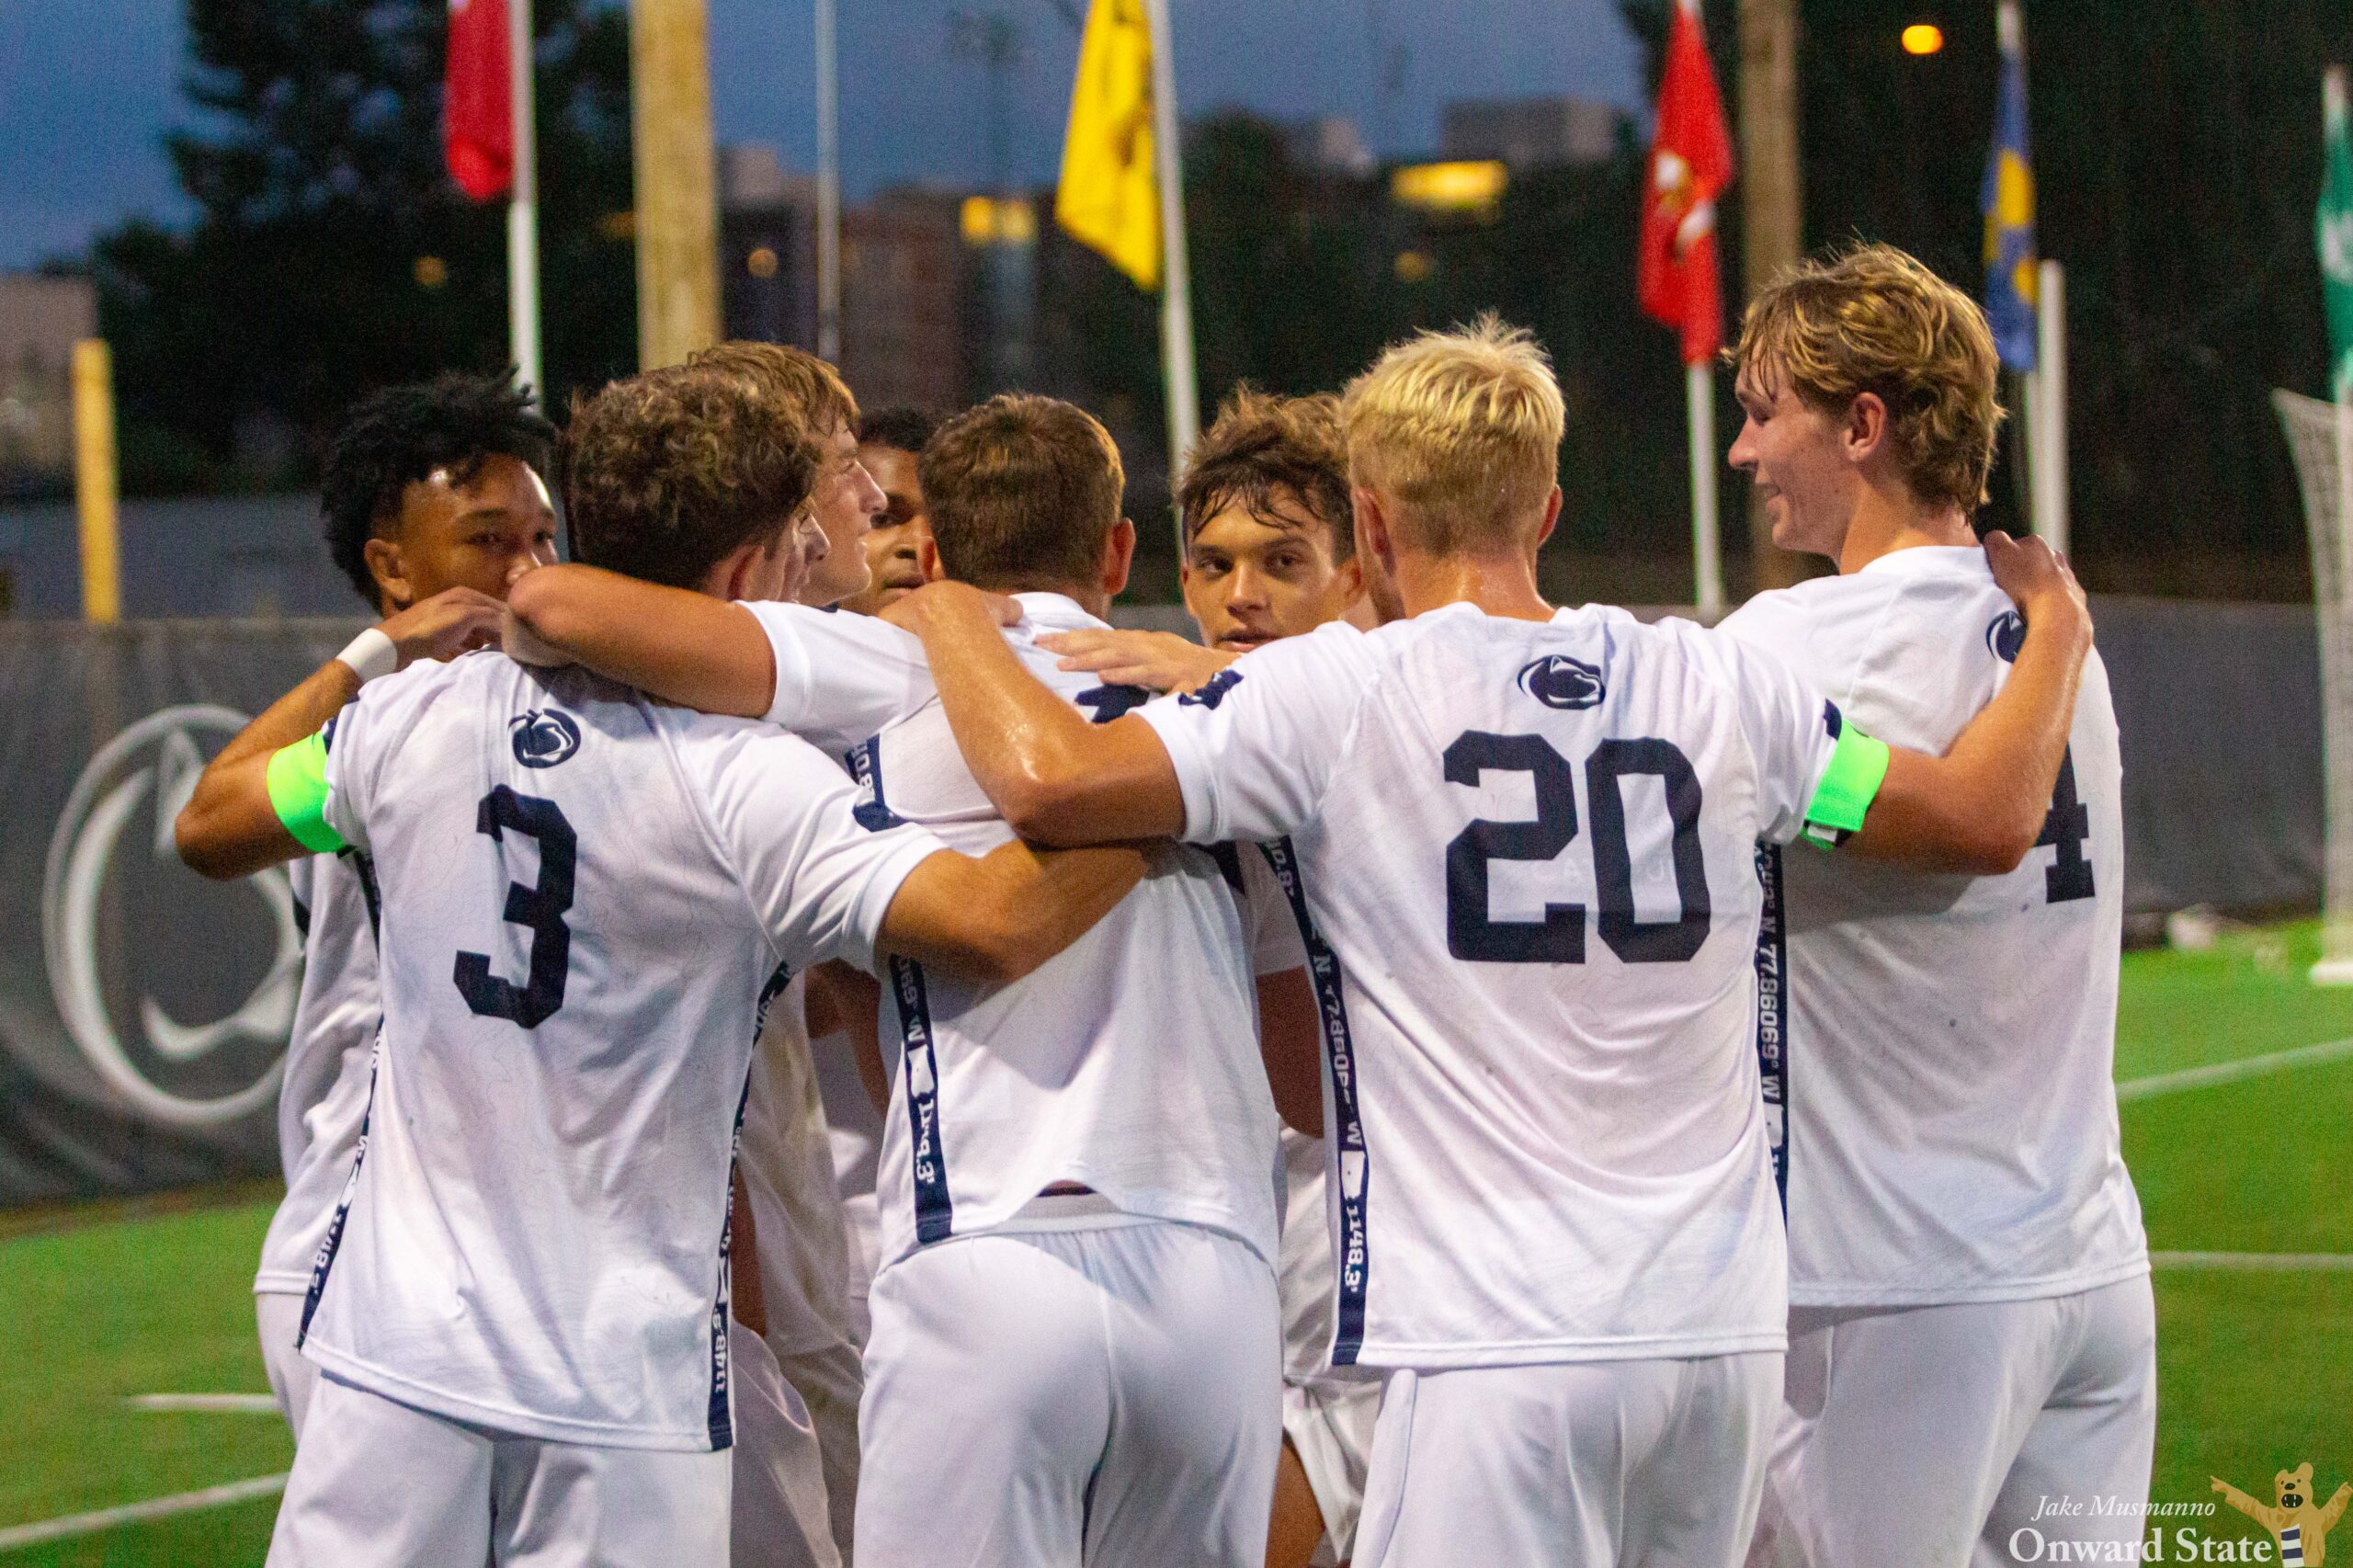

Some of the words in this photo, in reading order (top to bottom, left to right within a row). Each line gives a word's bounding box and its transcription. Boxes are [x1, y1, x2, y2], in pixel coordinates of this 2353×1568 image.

[452, 783, 578, 1029] 3
[1443, 730, 1711, 963] 20
[1762, 1074, 1781, 1100] W
